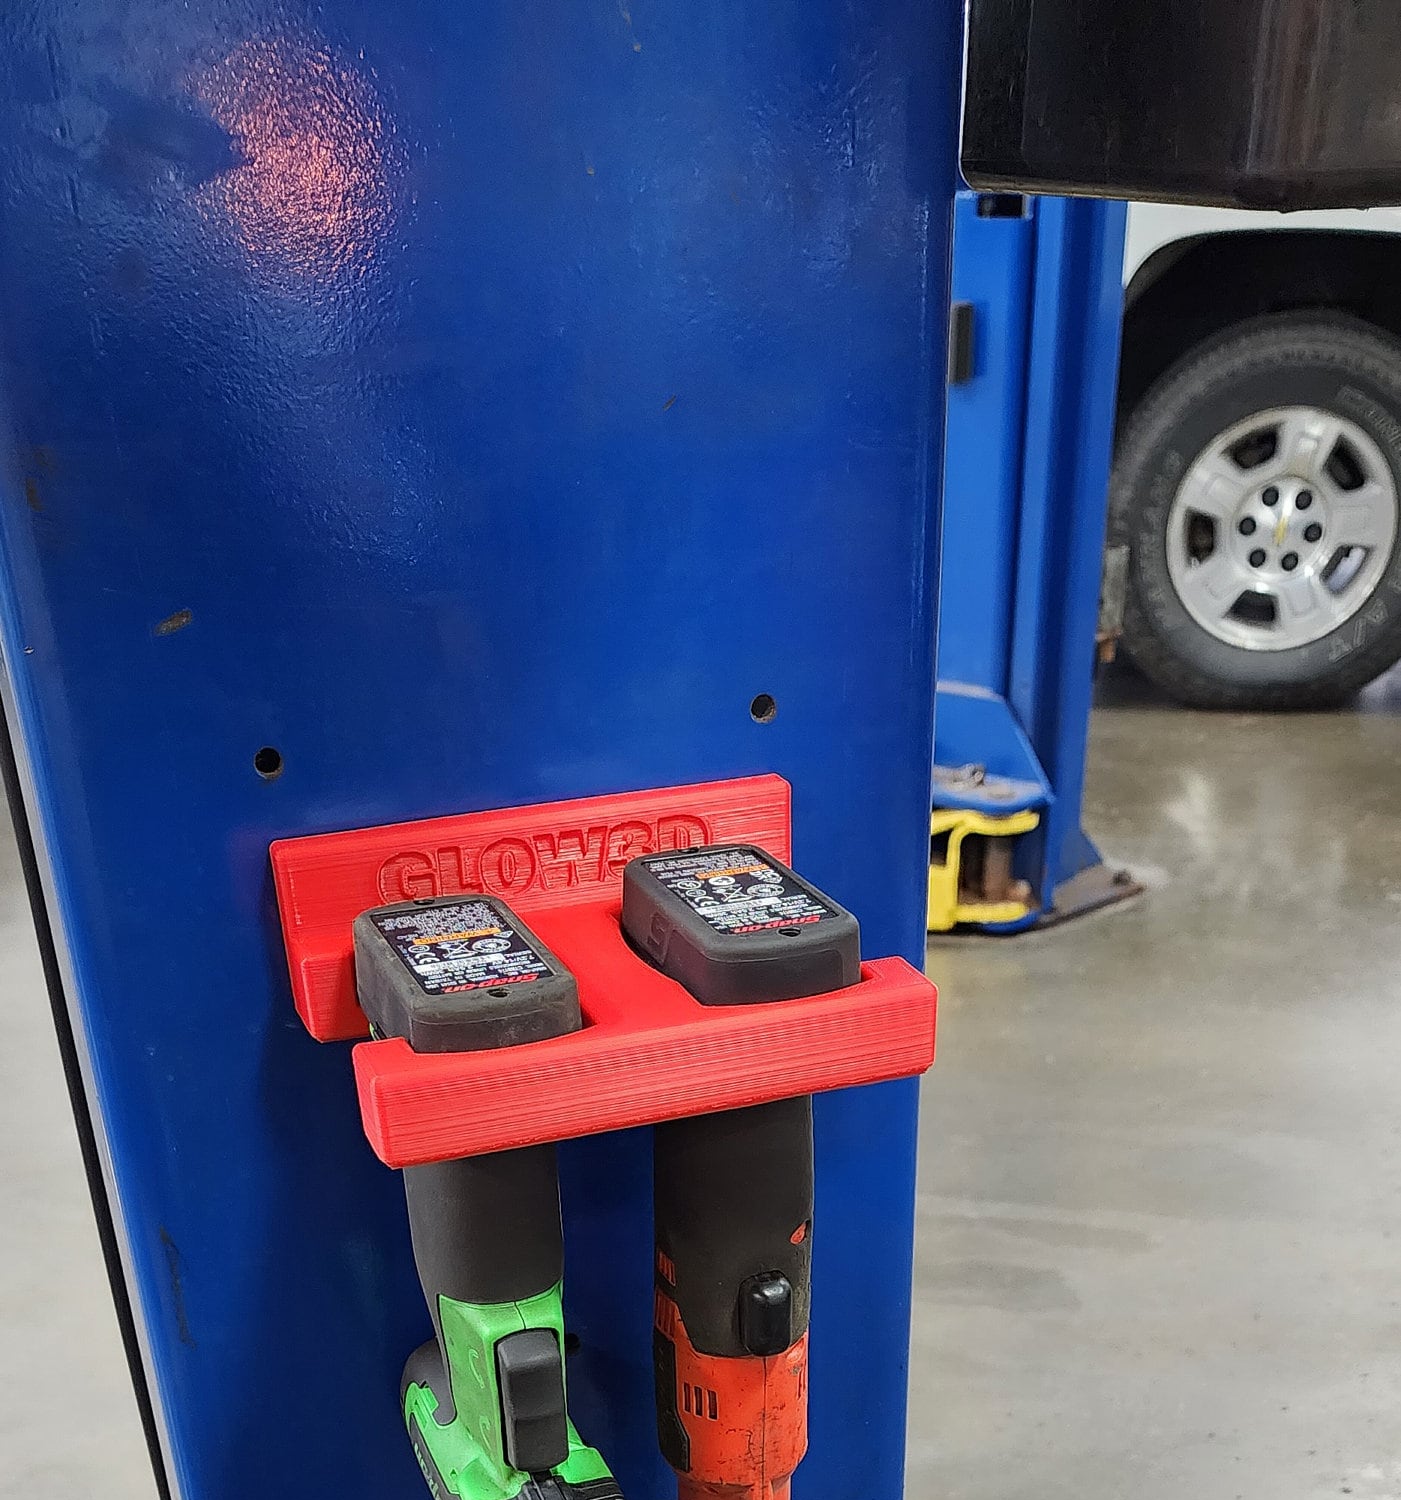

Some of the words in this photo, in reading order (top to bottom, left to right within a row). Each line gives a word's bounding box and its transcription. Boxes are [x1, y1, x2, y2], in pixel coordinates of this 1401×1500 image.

[377, 815, 713, 904] GLOW3D
[732, 914, 821, 934] Snap-on
[442, 973, 539, 993] Snap-on
